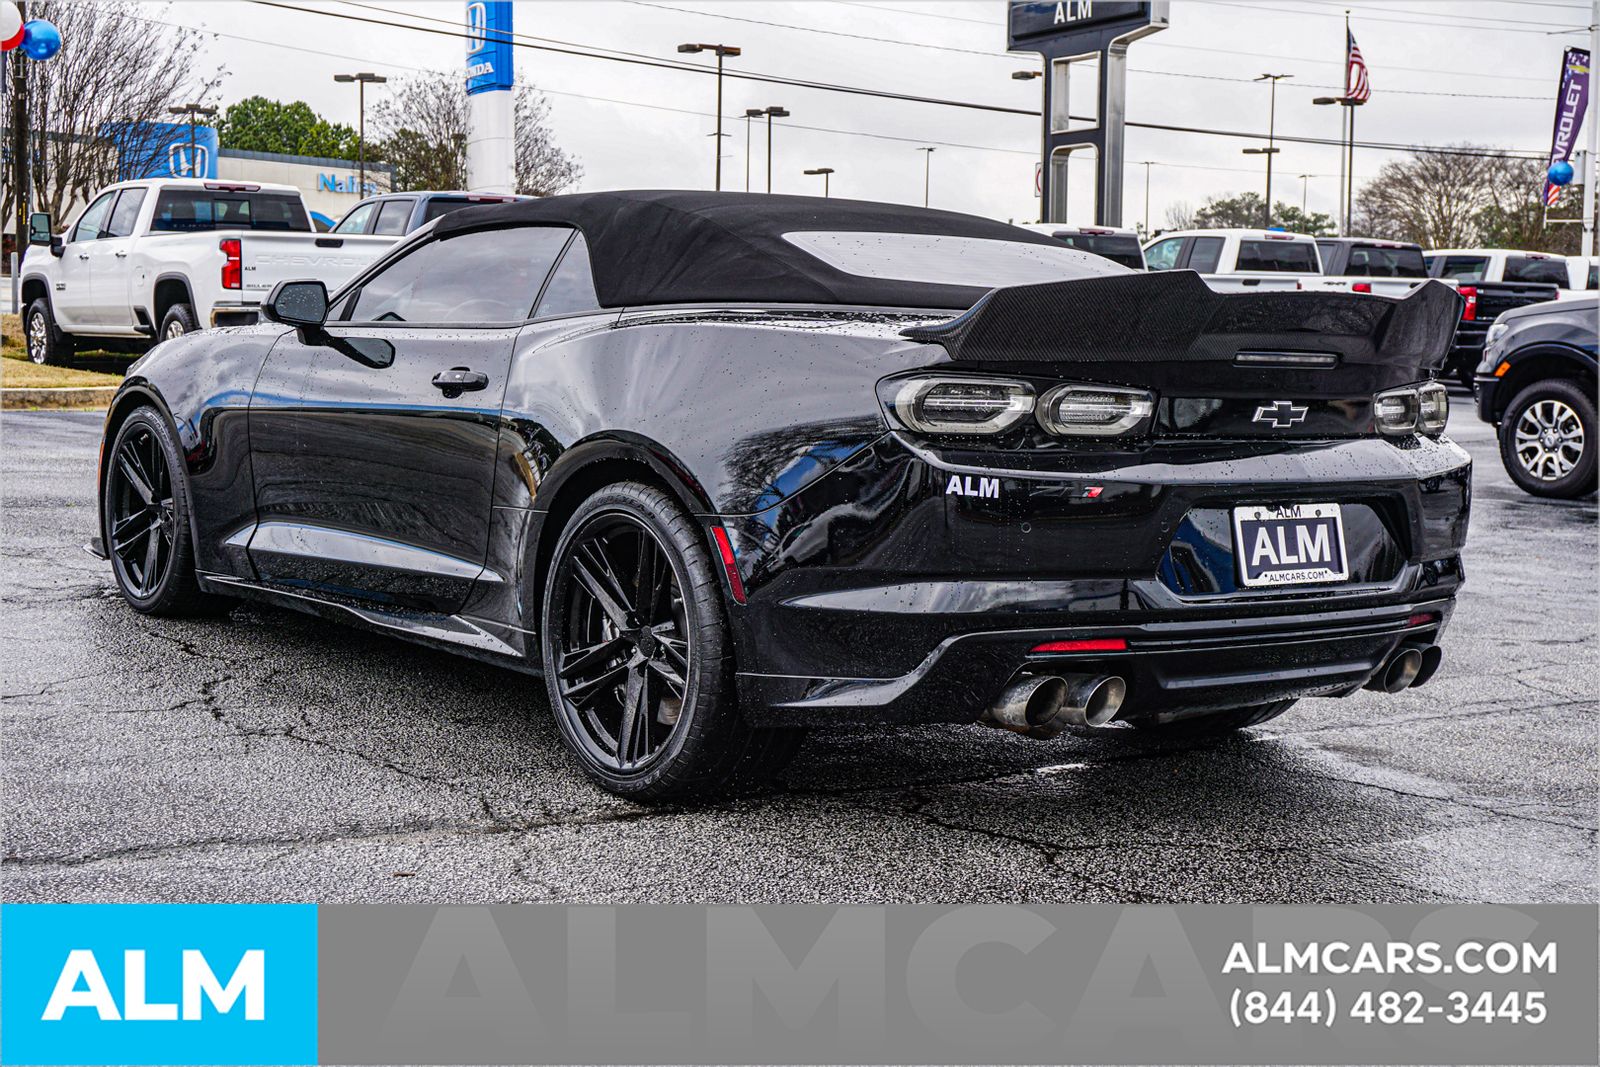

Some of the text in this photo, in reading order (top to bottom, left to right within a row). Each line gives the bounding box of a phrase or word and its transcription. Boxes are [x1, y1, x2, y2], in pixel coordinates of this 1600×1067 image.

[1054, 1, 1092, 24] ALM
[1551, 80, 1582, 163] VROLET
[945, 475, 1000, 499] ALM
[1276, 505, 1301, 518] ALM
[1251, 524, 1331, 566] ALM
[1269, 571, 1325, 583] ALMCARS.COM
